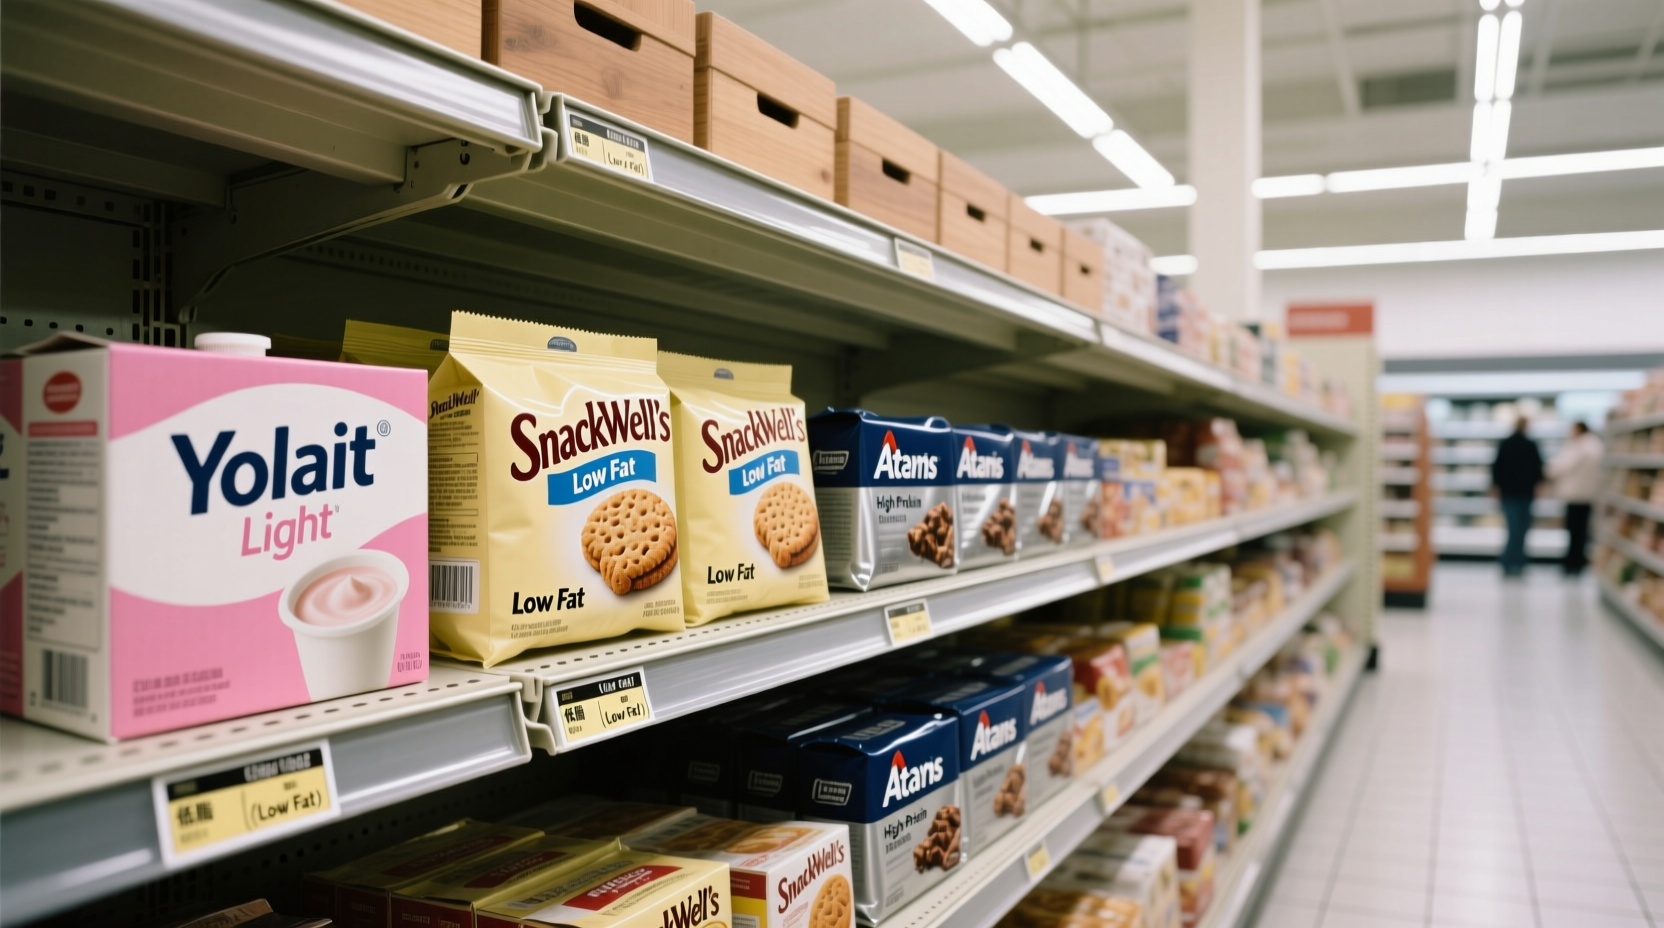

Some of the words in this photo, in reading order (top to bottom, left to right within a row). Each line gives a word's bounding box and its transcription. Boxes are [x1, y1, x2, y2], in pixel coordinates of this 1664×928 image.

[511, 398, 670, 482] SnackWell's
[701, 407, 806, 474] SnackWell's
[171, 421, 376, 516] Yolait
[572, 466, 606, 495] Low
[610, 457, 636, 481] Fat
[742, 461, 765, 487] Low
[767, 454, 786, 476] Fat
[240, 503, 333, 561] Light
[707, 565, 735, 585] Low
[512, 591, 553, 615] Low
[556, 587, 586, 611] Fat
[777, 840, 845, 914] SnackWell's
[659, 884, 720, 928] kWell's
